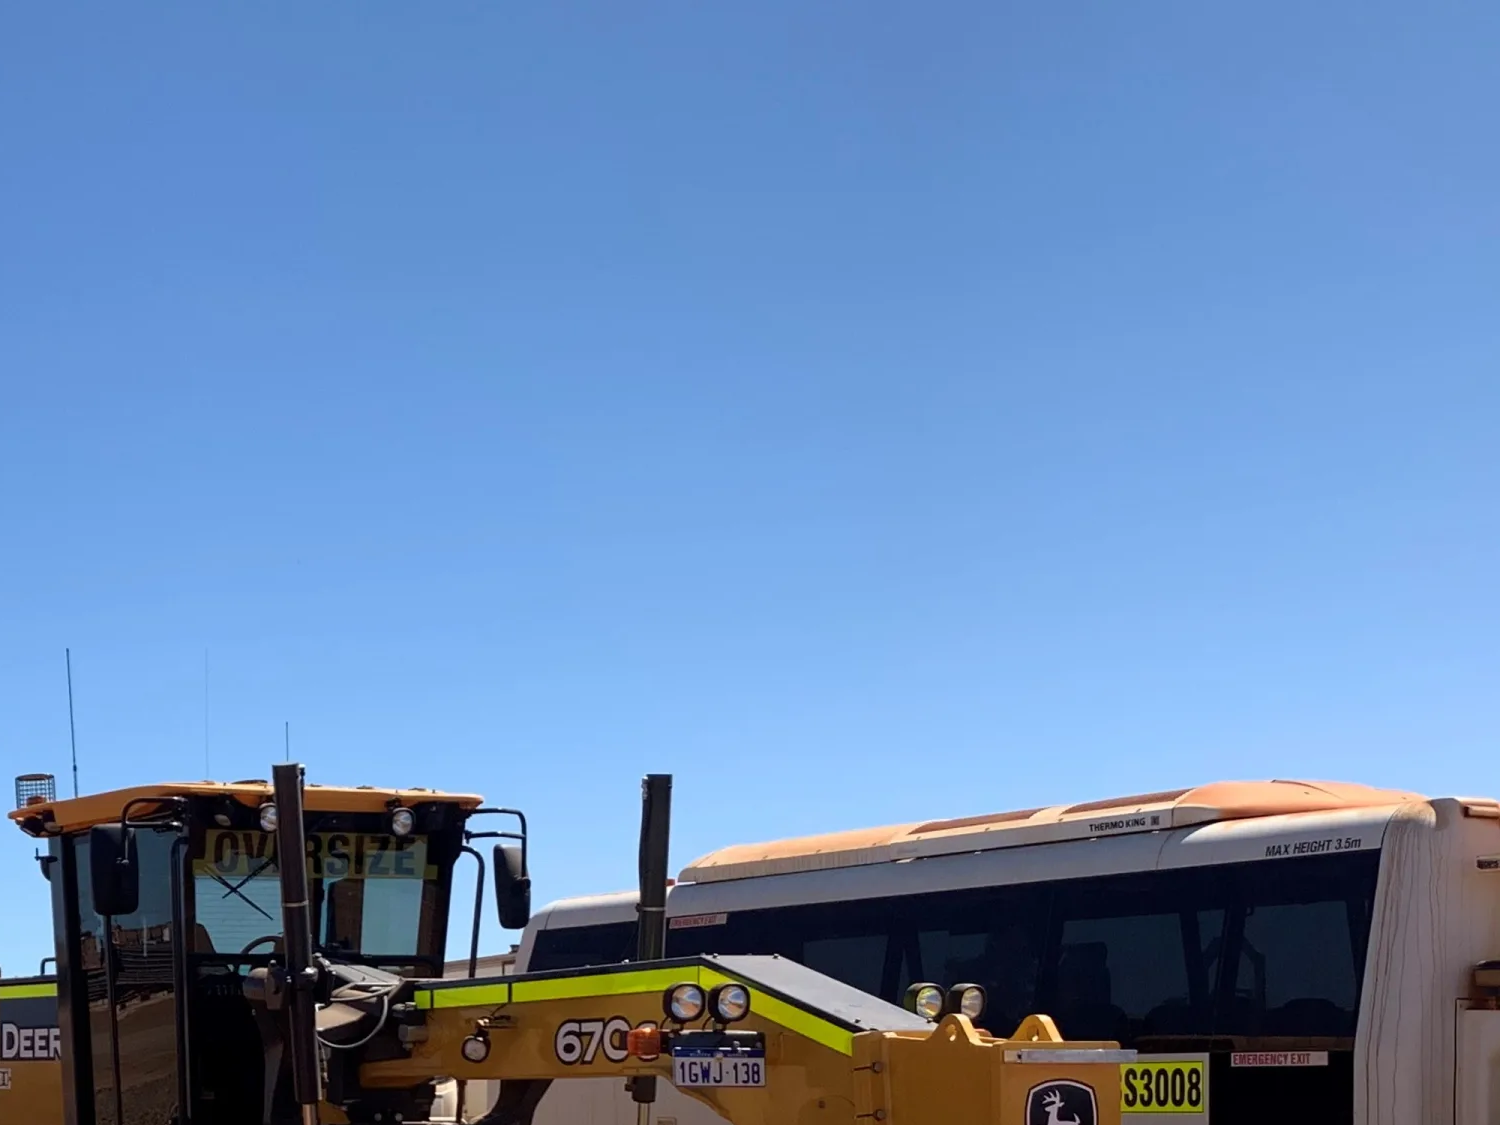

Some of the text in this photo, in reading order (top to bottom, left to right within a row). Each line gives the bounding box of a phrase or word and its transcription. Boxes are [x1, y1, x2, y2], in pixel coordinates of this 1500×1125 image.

[1088, 817, 1146, 833] THERMO KING
[213, 831, 416, 875] OVRSIZE
[1265, 837, 1362, 857] MAX HEIGHT 3.5m
[1232, 1052, 1311, 1065] EMERGENCY EXIT
